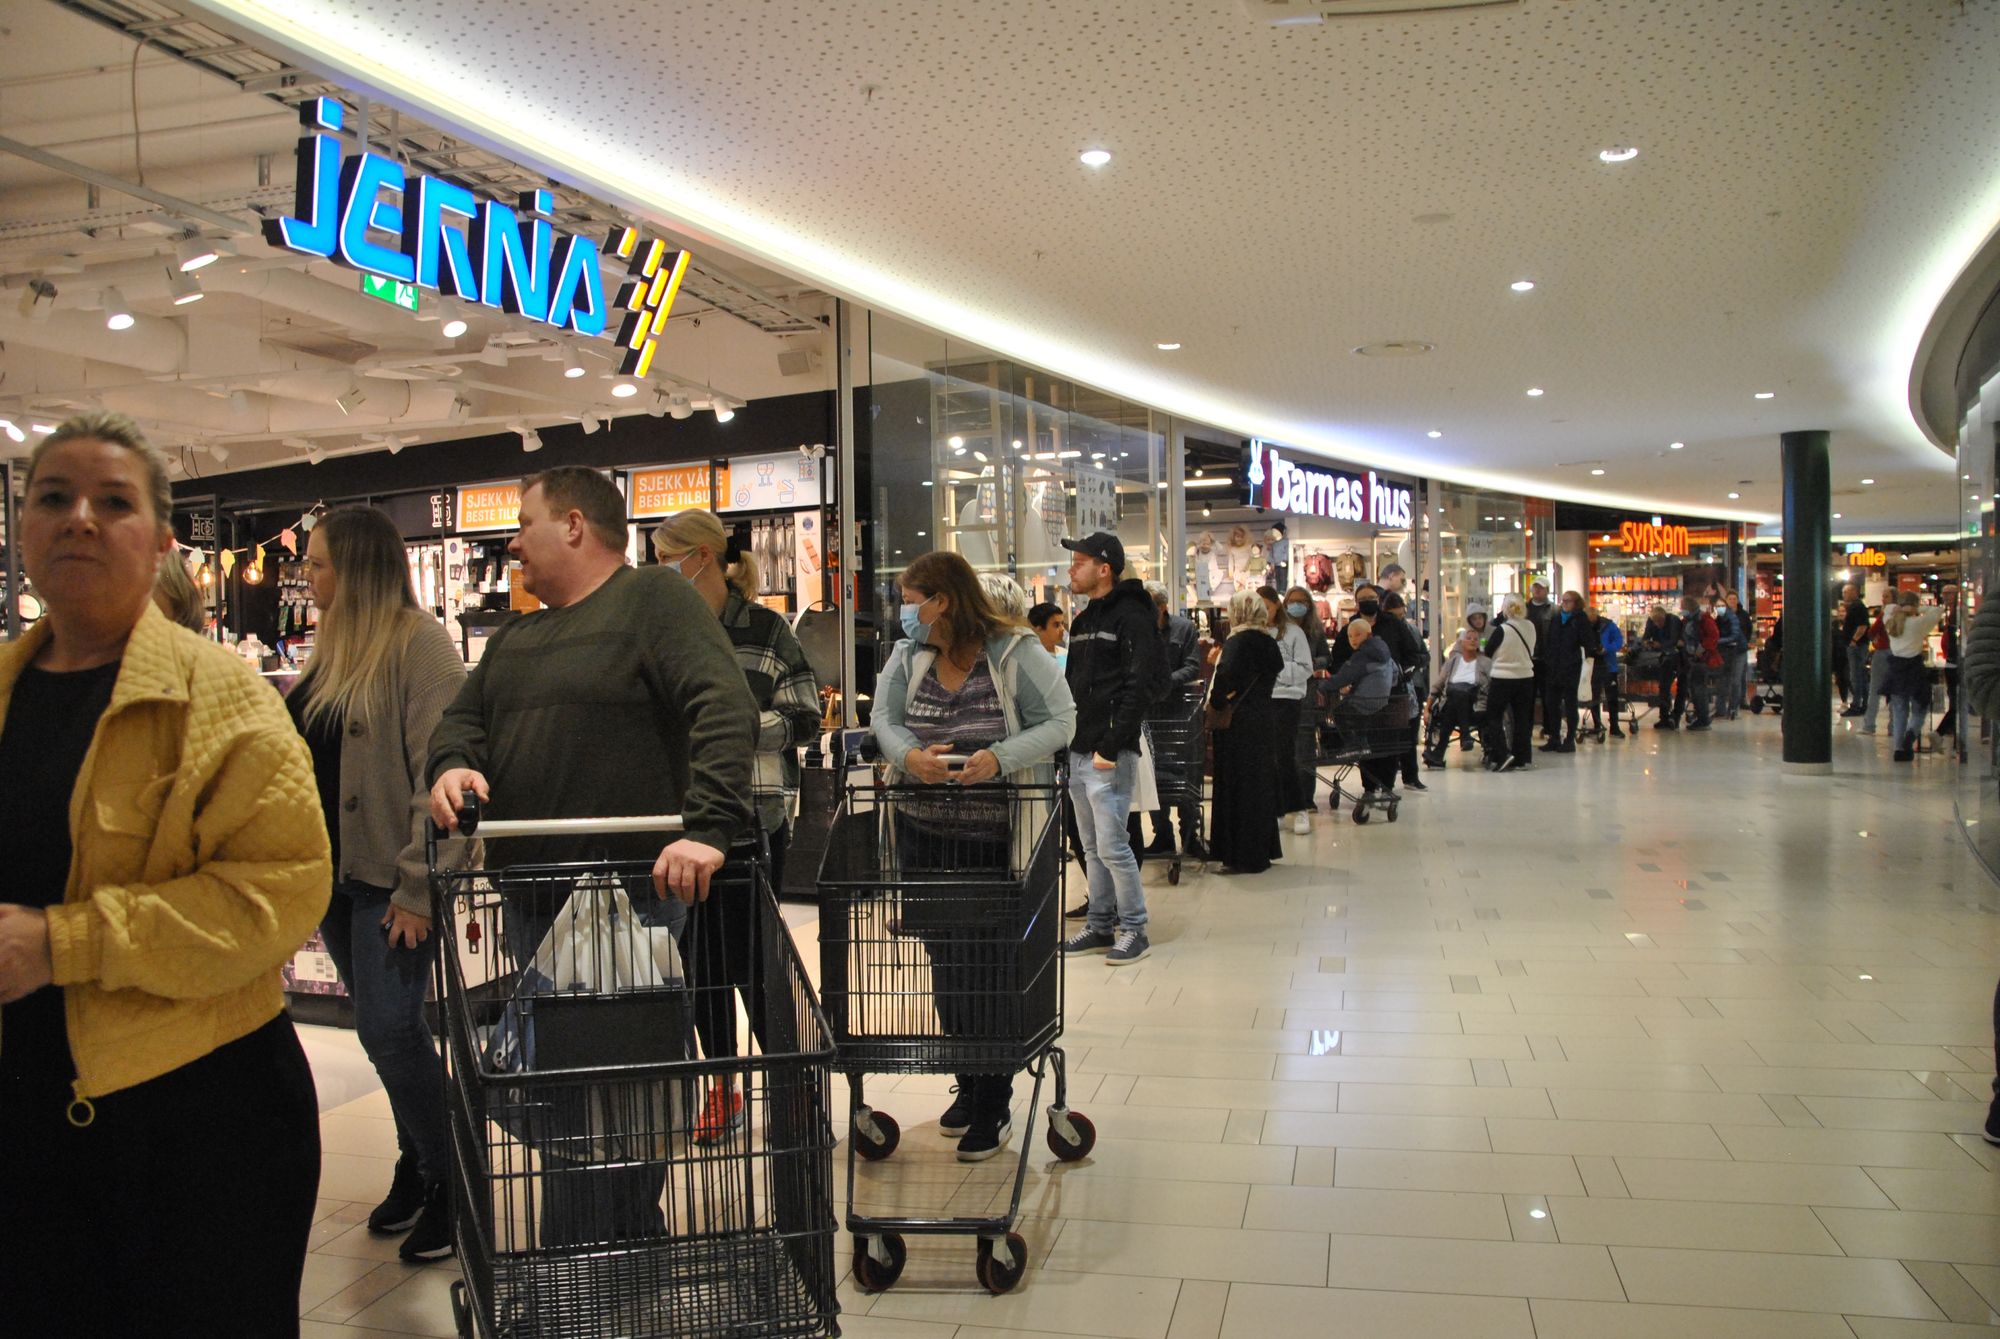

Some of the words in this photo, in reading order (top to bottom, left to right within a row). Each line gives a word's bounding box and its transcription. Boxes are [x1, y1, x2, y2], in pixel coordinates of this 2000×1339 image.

[639, 473, 683, 493] SJEKK
[1269, 449, 1364, 522] barnas
[1369, 471, 1411, 528] hus
[466, 491, 503, 508] SJEKK
[505, 486, 521, 505] VÅ
[638, 492, 674, 508] BESTE
[465, 509, 496, 523] BESTE
[497, 506, 519, 521] TILB
[1621, 521, 1689, 555] SYNSAM
[1850, 547, 1887, 566] nille
